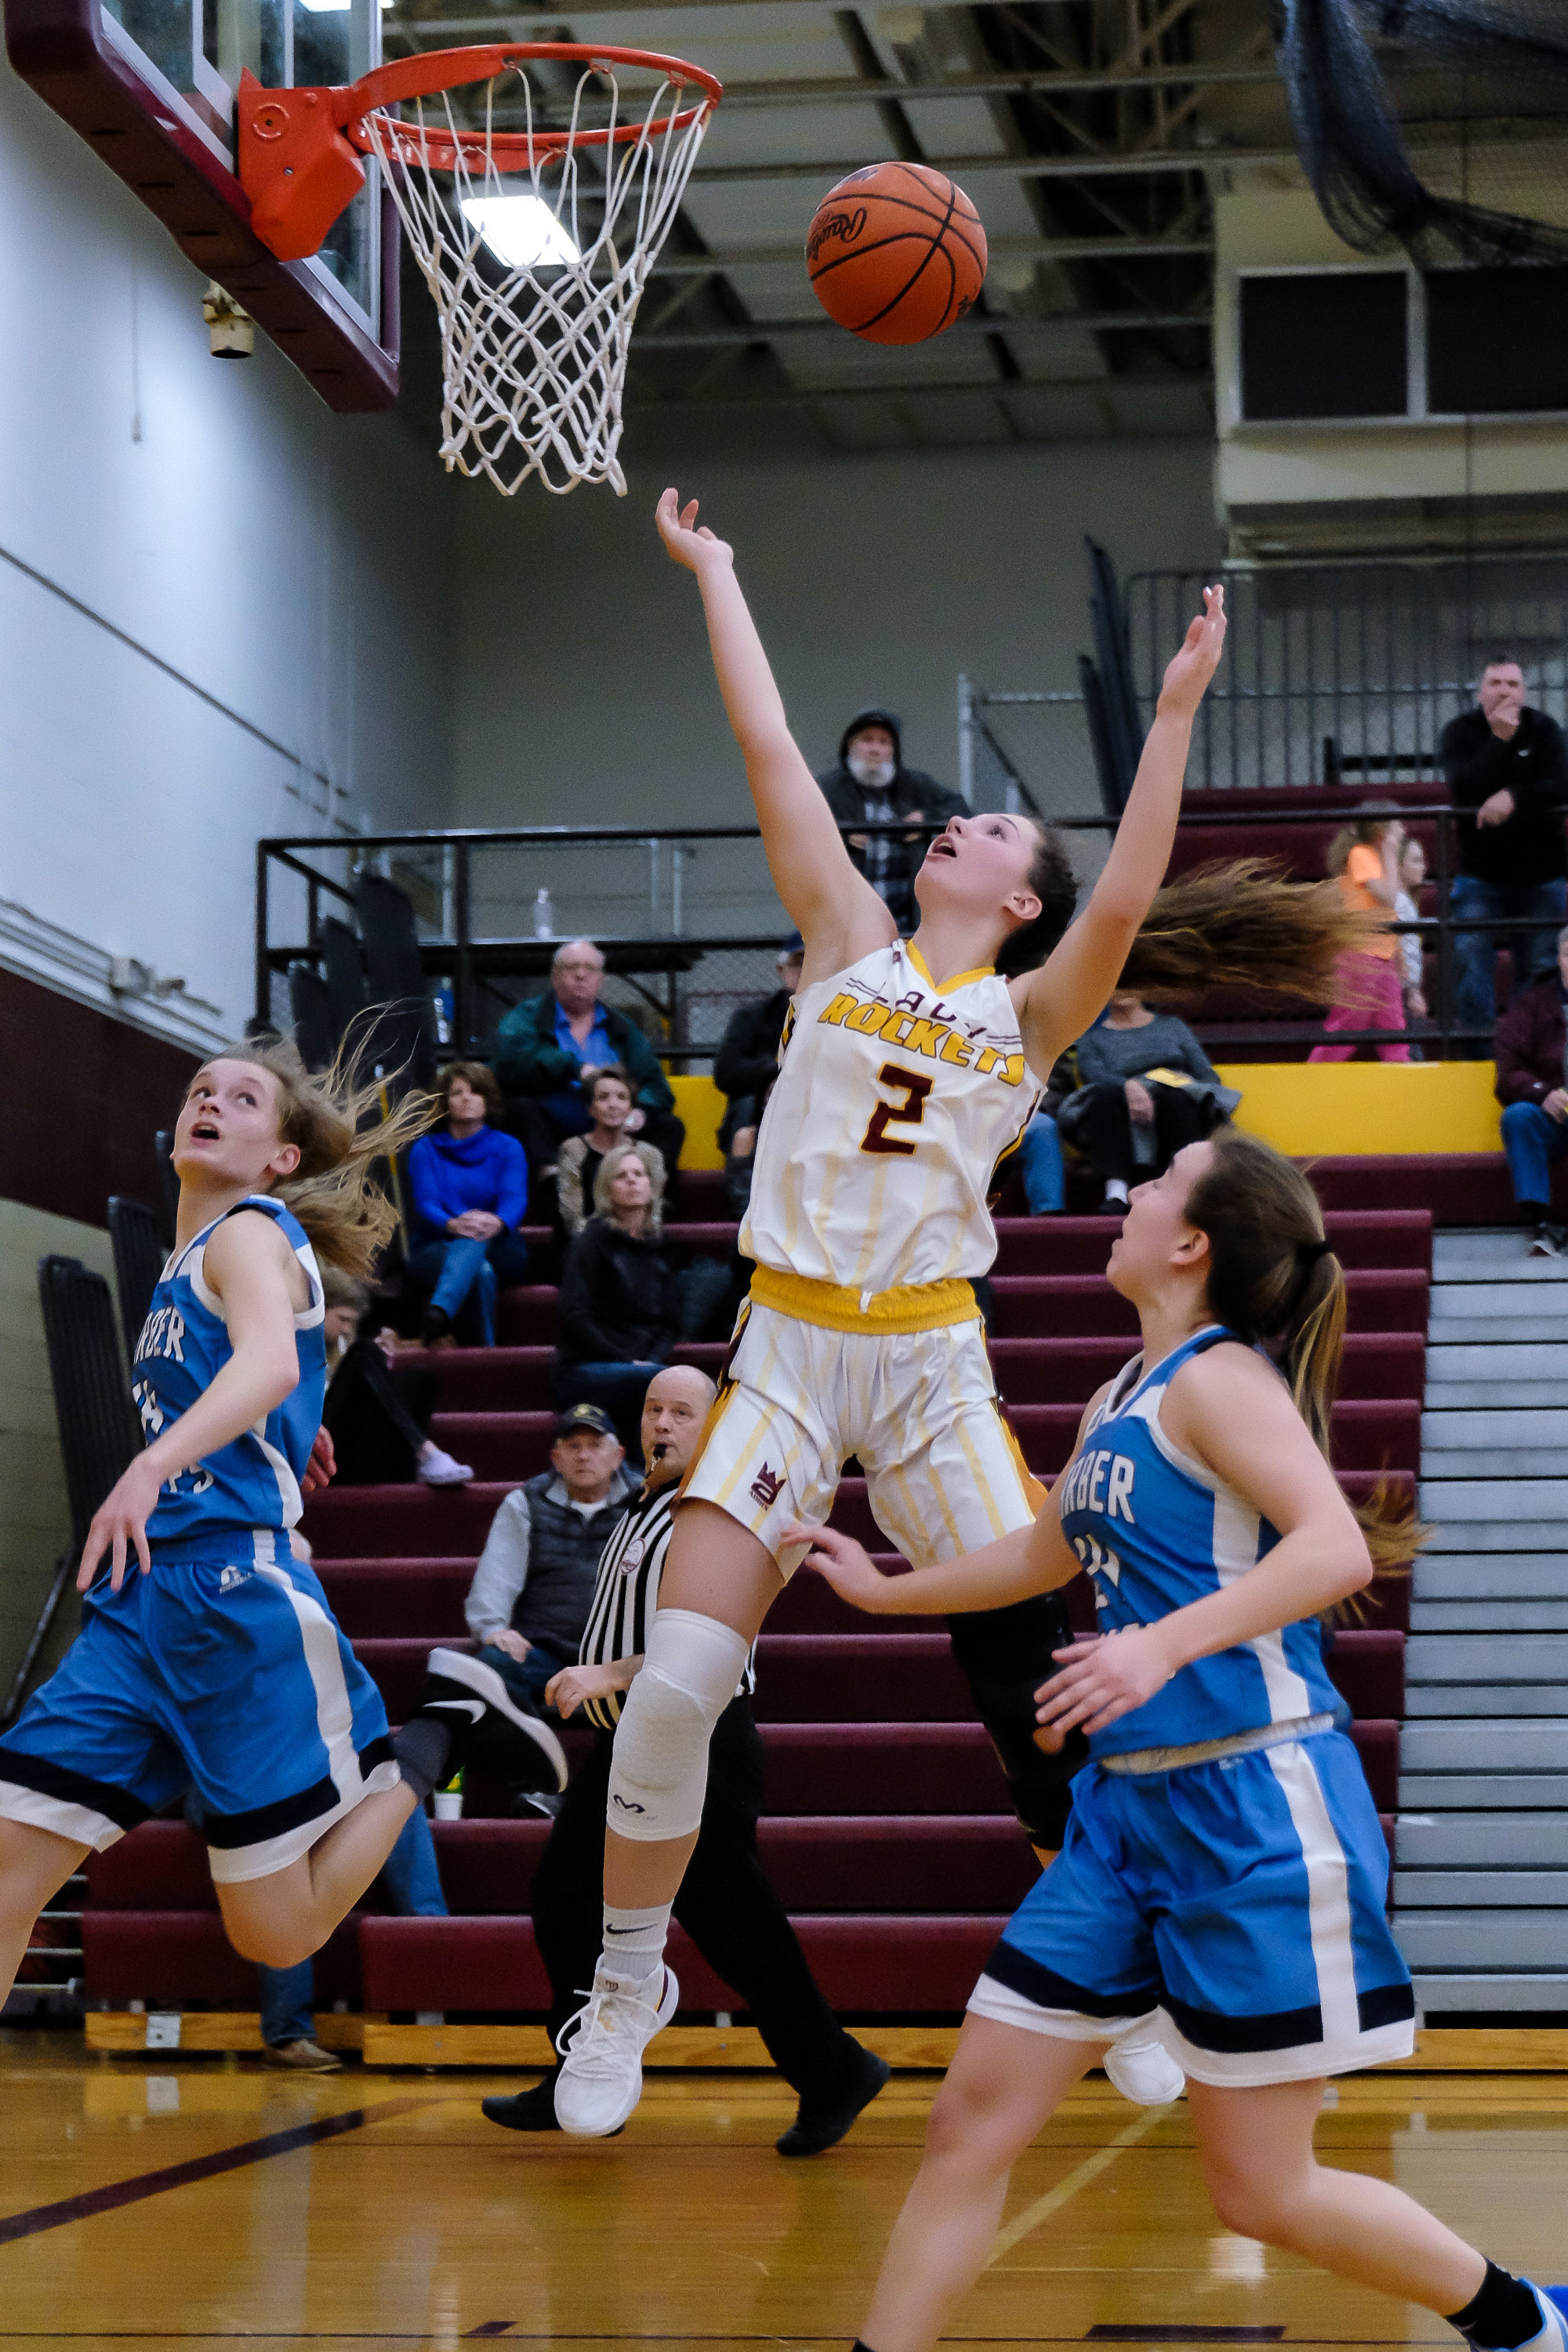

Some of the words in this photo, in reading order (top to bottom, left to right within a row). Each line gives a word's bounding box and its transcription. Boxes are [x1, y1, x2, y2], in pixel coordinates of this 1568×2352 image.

[817, 992, 1025, 1087] ROCKETS
[858, 1061, 935, 1156] 2
[1060, 1449, 1136, 1524] RBER
